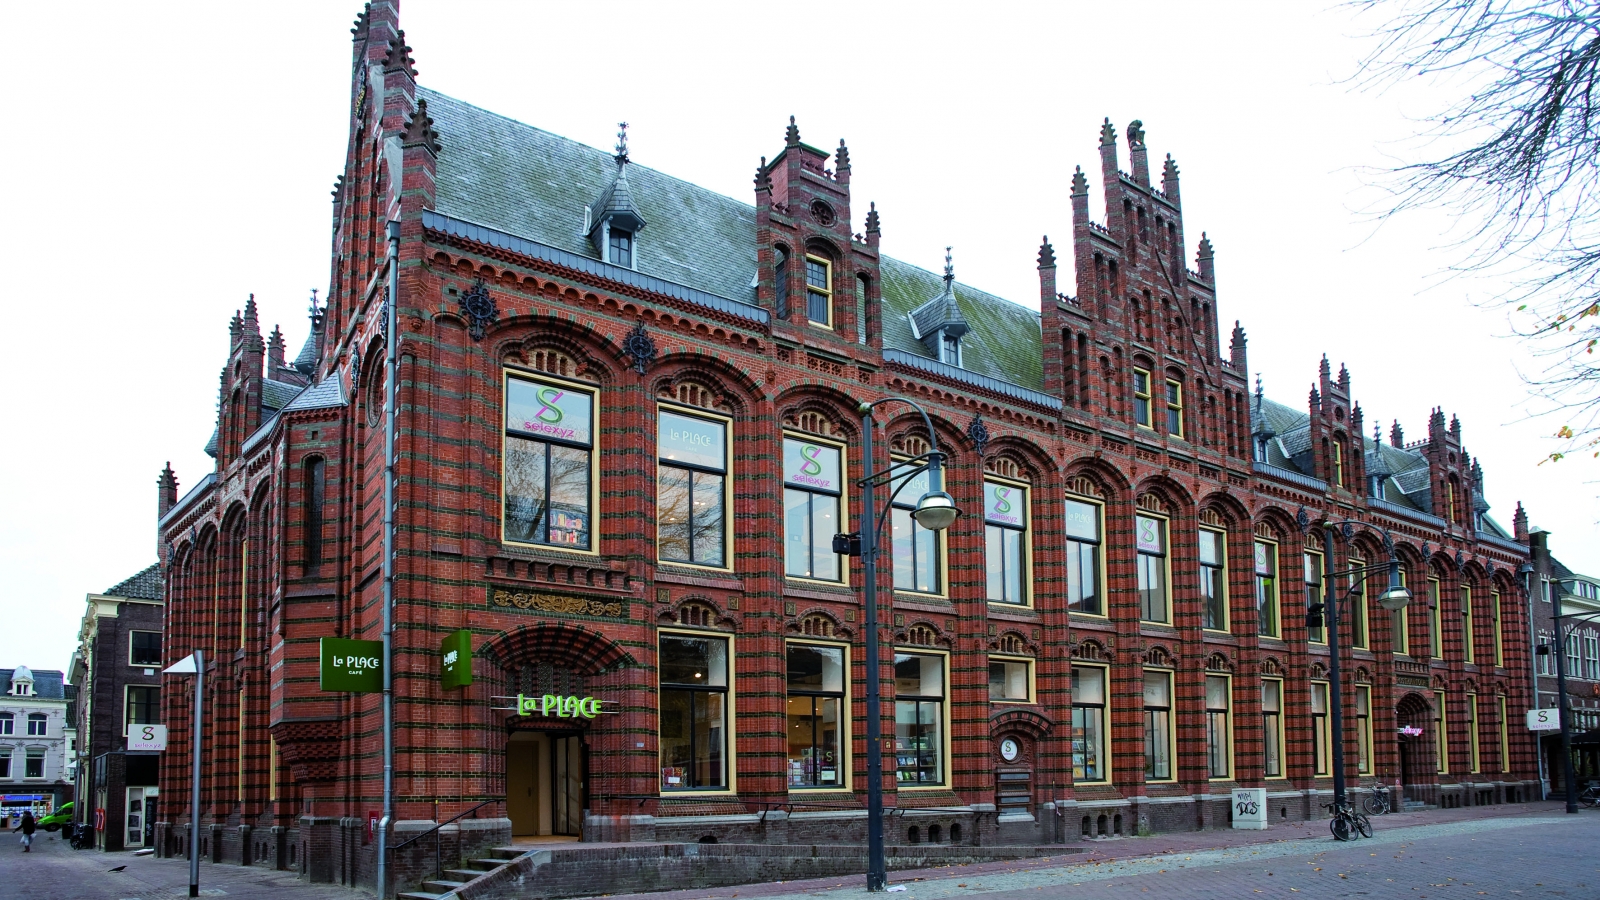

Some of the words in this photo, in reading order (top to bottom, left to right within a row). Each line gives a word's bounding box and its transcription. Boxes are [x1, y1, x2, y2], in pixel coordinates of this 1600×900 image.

[524, 421, 574, 438] selexyz
[670, 428, 680, 440] La
[682, 430, 711, 447] PLACE
[792, 474, 830, 488] selexyz
[988, 512, 1018, 524] selexyz
[1075, 512, 1091, 524] PLACE
[333, 655, 344, 667] La
[346, 655, 379, 669] PLACE
[517, 693, 536, 716] La
[541, 694, 603, 718] PLACE
